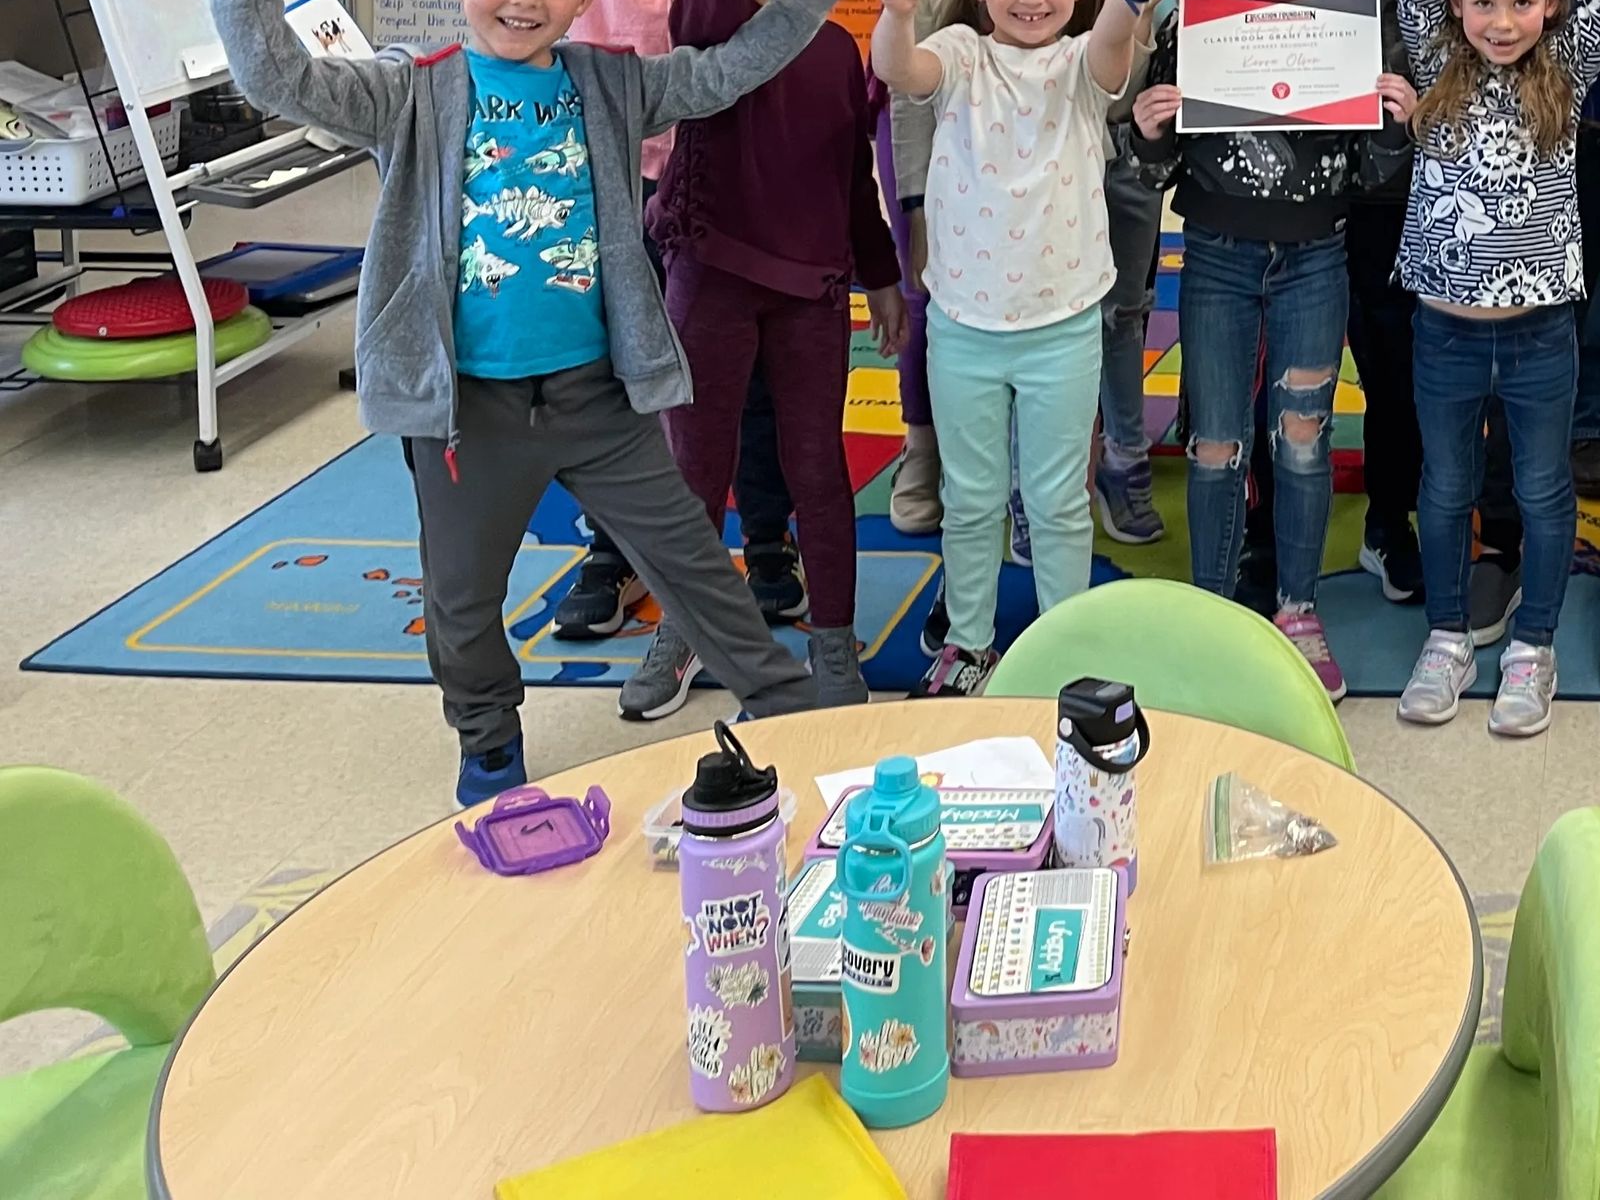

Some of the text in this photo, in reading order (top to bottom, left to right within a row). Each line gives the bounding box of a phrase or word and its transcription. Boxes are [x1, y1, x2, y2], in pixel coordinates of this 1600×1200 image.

[380, 14, 444, 28] respect the
[1245, 10, 1316, 23] EDUCATION FOUNDATION
[1204, 34, 1264, 44] CLASSROOM
[1269, 32, 1302, 41] GRANT
[1306, 30, 1358, 39] RECIPIENT
[705, 894, 760, 915] IF NOT
[708, 912, 755, 932] NOW
[708, 918, 768, 953] WHEN?
